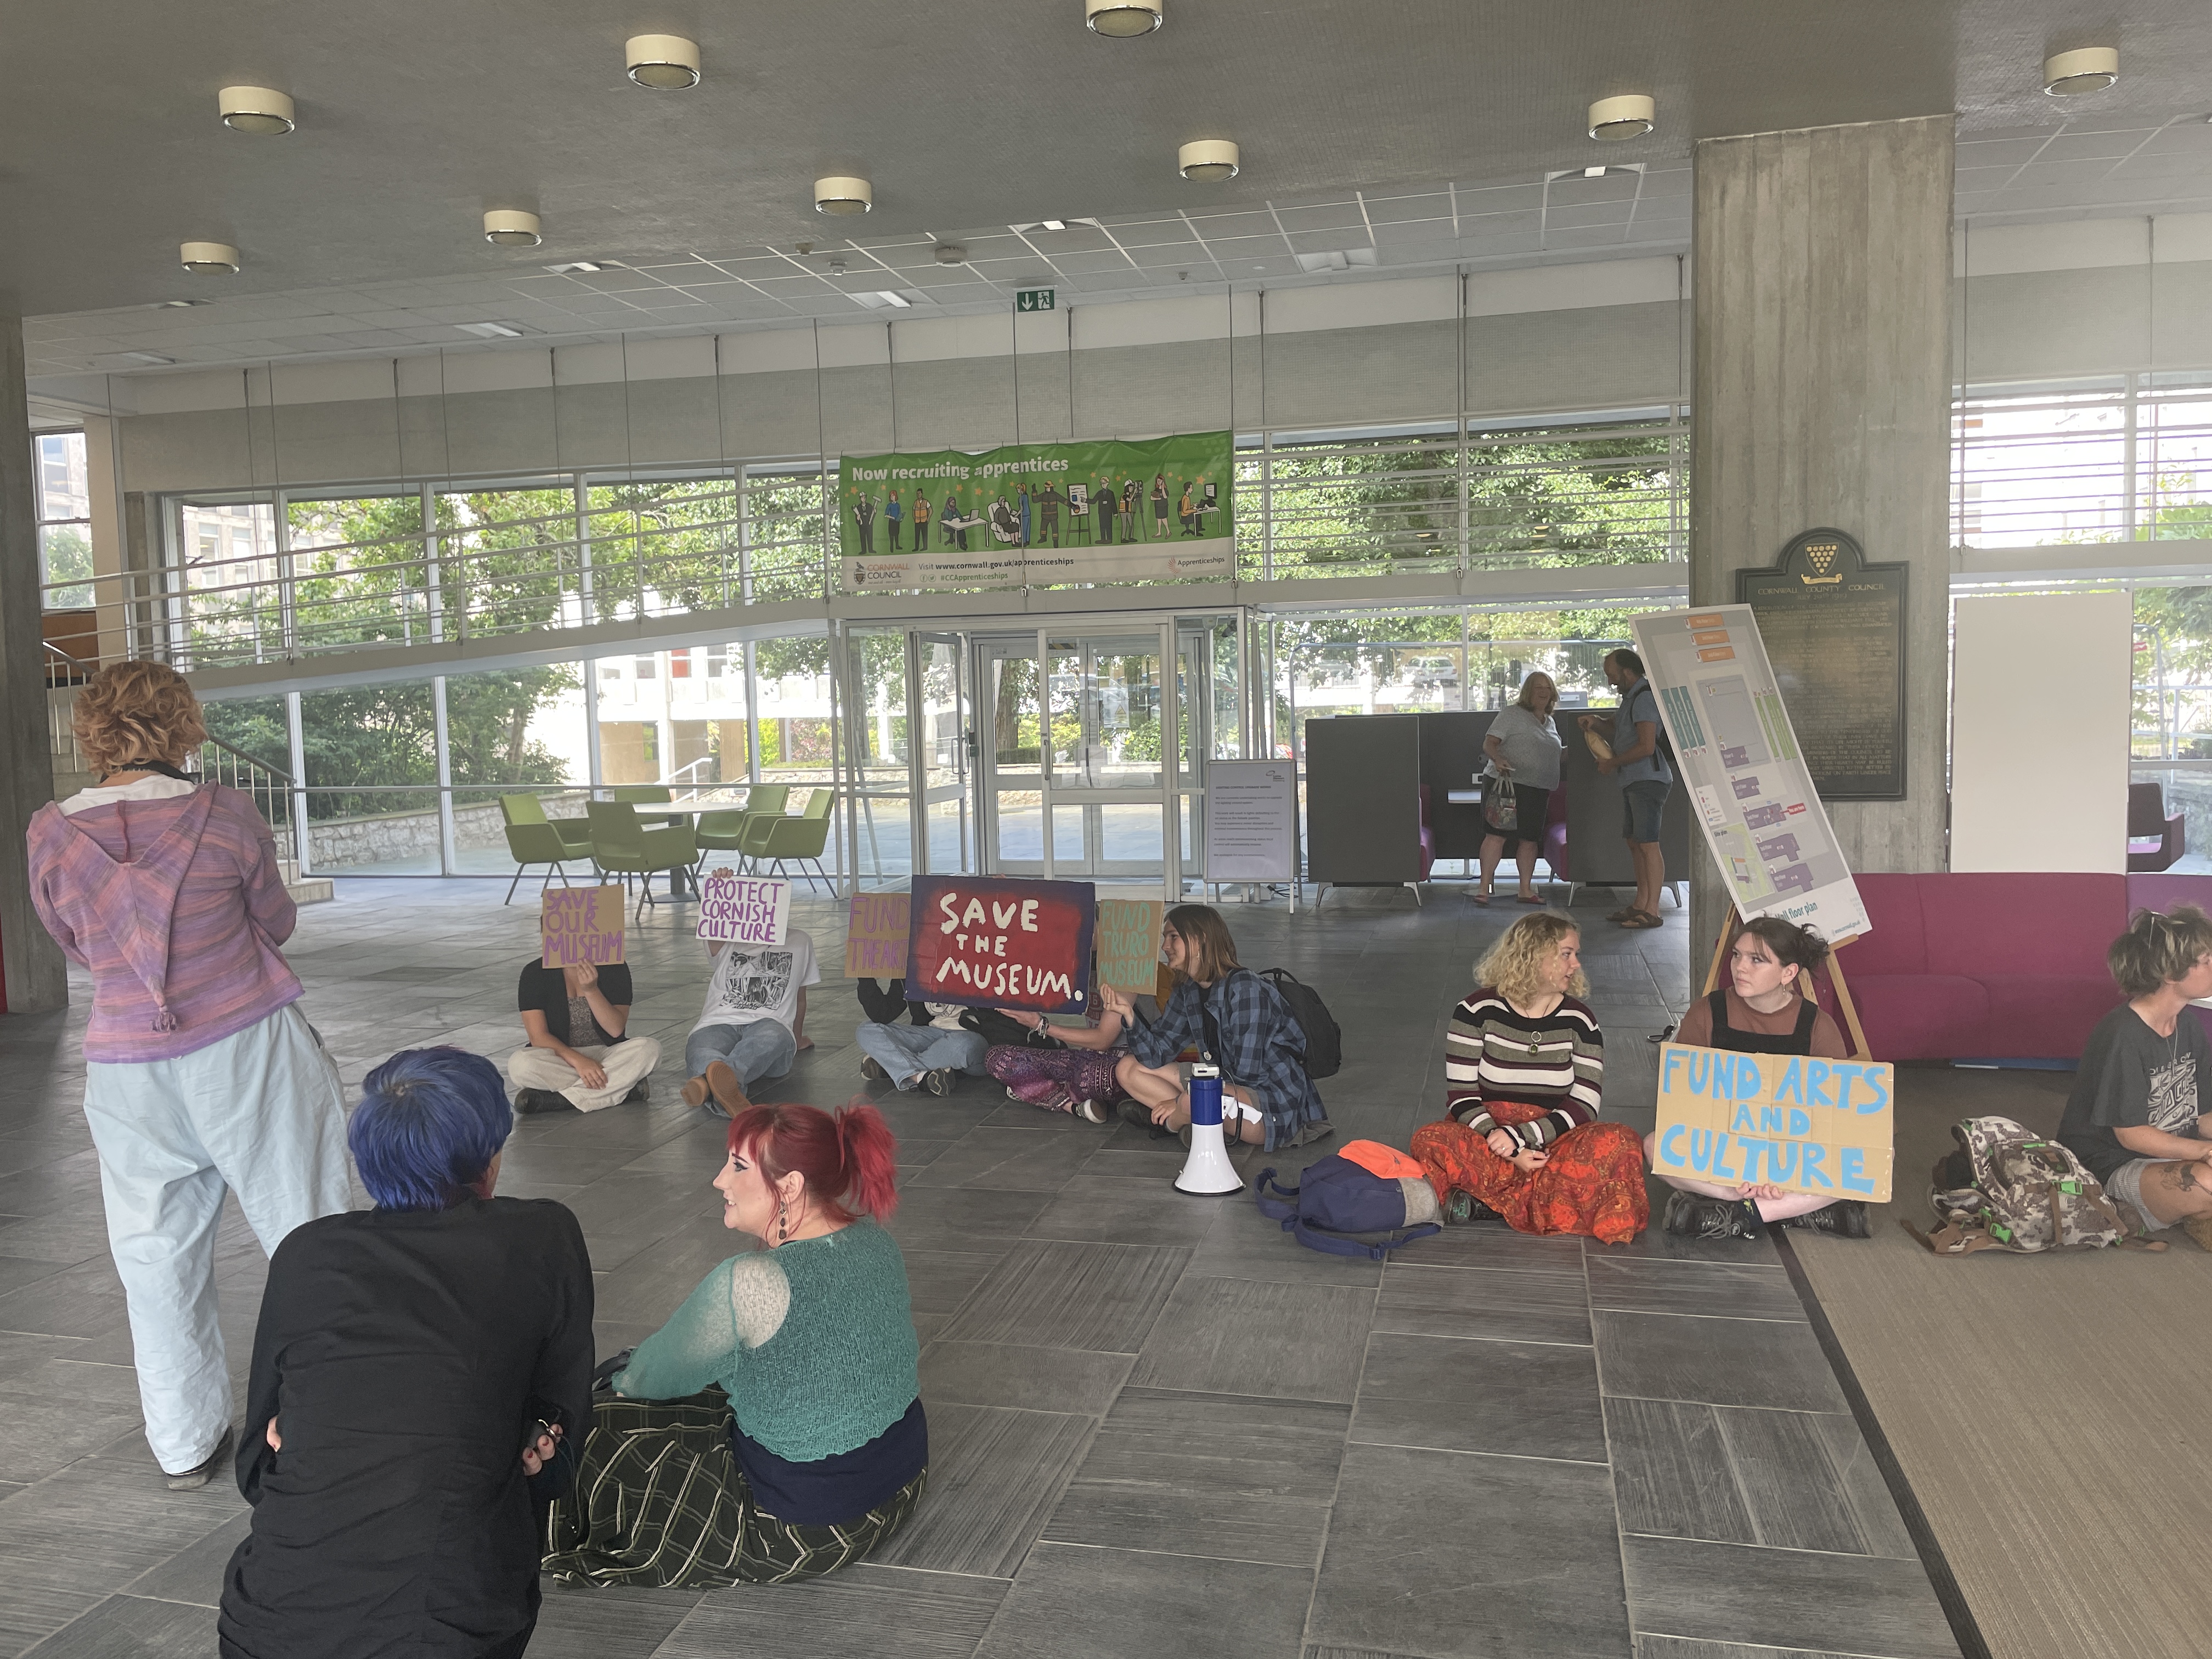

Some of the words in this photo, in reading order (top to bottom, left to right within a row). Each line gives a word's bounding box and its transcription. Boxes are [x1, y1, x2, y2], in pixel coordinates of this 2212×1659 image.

[852, 467, 888, 481] Now
[892, 461, 970, 480] recruiting
[974, 456, 1069, 479] apprentices
[867, 563, 910, 572] CORNWALL
[935, 557, 1074, 570] www.cornwall.gov.uk/apprenticeships
[1177, 556, 1225, 567] Apprenticeships
[867, 571, 901, 579] COUNCIL
[940, 572, 1008, 582] #CCApprenticeships
[1757, 587, 1798, 595] CORNWALL
[1805, 585, 1841, 593] COUNTY
[1848, 583, 1886, 591] COUNCIL
[546, 889, 599, 911] SAVE
[704, 878, 784, 906] PROTECT
[545, 911, 599, 933] OUR
[702, 899, 776, 923] CORNISH
[850, 897, 910, 933] FUND
[939, 892, 1040, 934] SAVE
[1102, 902, 1150, 929] FUND
[1788, 907, 1804, 919] floor
[1804, 901, 1818, 916] plan
[698, 919, 776, 943] CULTURE
[544, 930, 622, 966] MUSEUM
[956, 933, 1008, 957] THE
[1101, 932, 1150, 957] TRURO
[936, 956, 1084, 1001] MUSEUM.
[1098, 958, 1154, 986] MUSEUM
[1663, 1049, 1762, 1100] FUND
[1774, 1057, 1888, 1115] ARTS
[1731, 1104, 1811, 1136] AND
[1660, 1124, 1875, 1195] CULTURE
